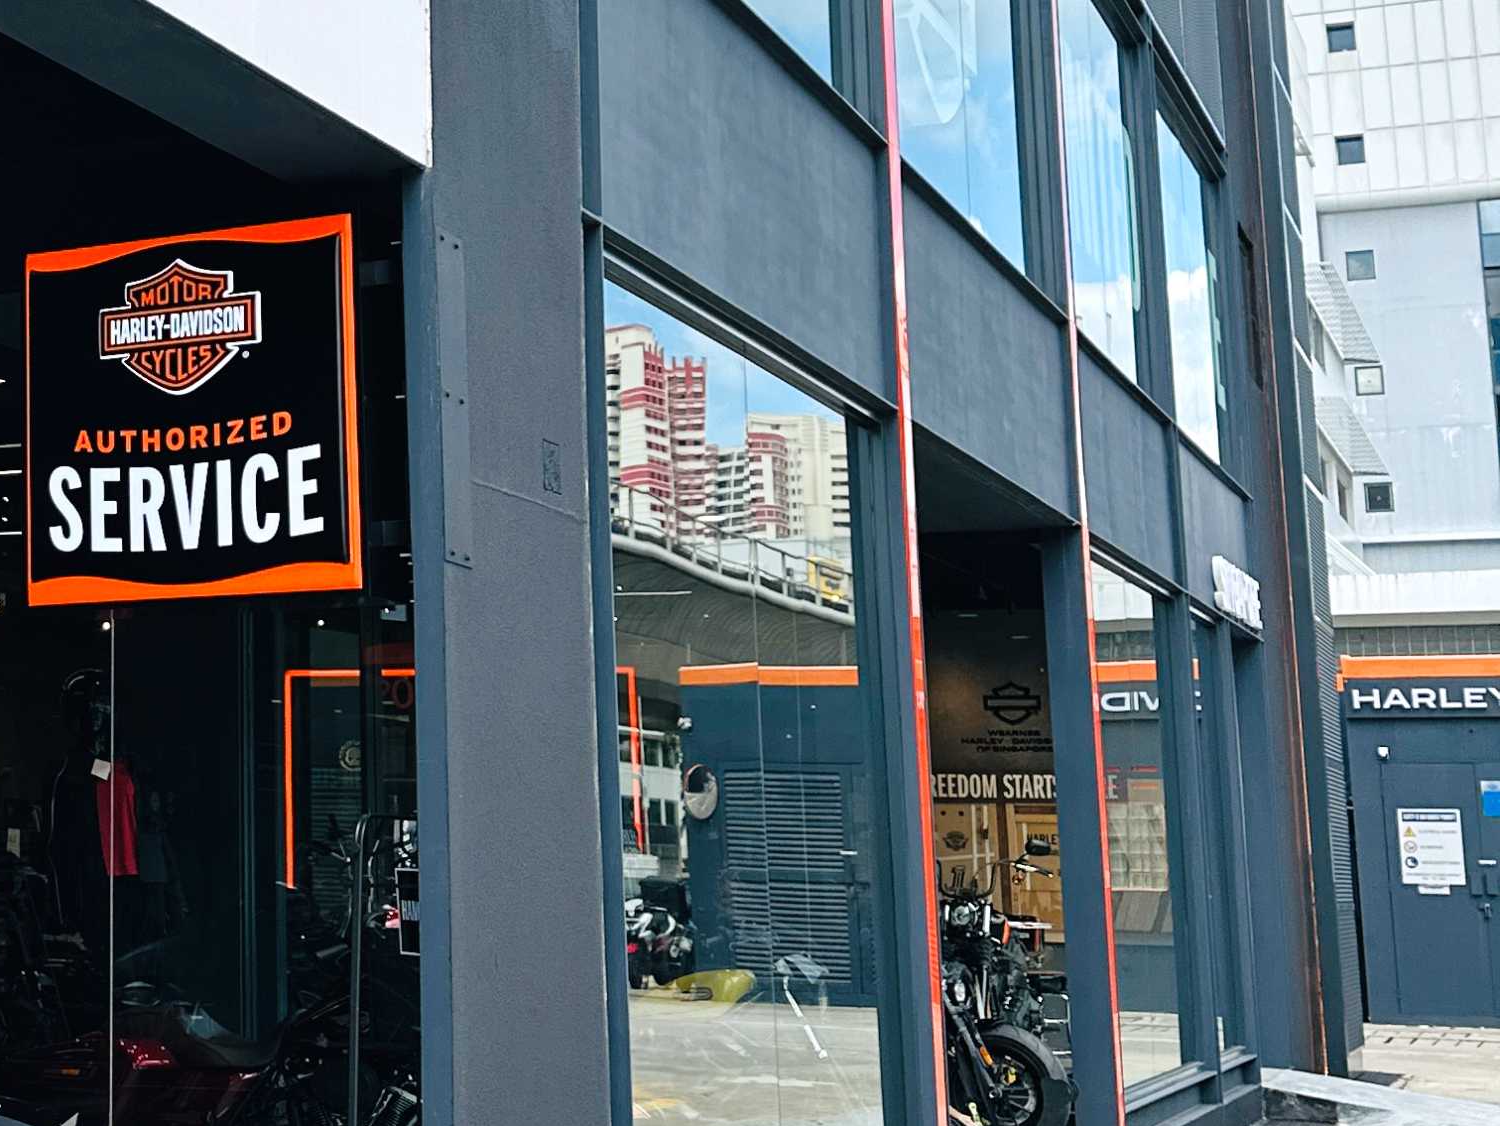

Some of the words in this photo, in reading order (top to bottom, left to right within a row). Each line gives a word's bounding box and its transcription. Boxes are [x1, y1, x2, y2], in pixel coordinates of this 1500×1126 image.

[140, 275, 212, 307] MOTOR
[109, 304, 245, 346] HARLEY-DAVIDSON
[140, 344, 212, 382] CYCLES
[74, 410, 293, 454] AUTHORIZED
[48, 443, 325, 553] SERVICE
[931, 773, 998, 799] REEDOM
